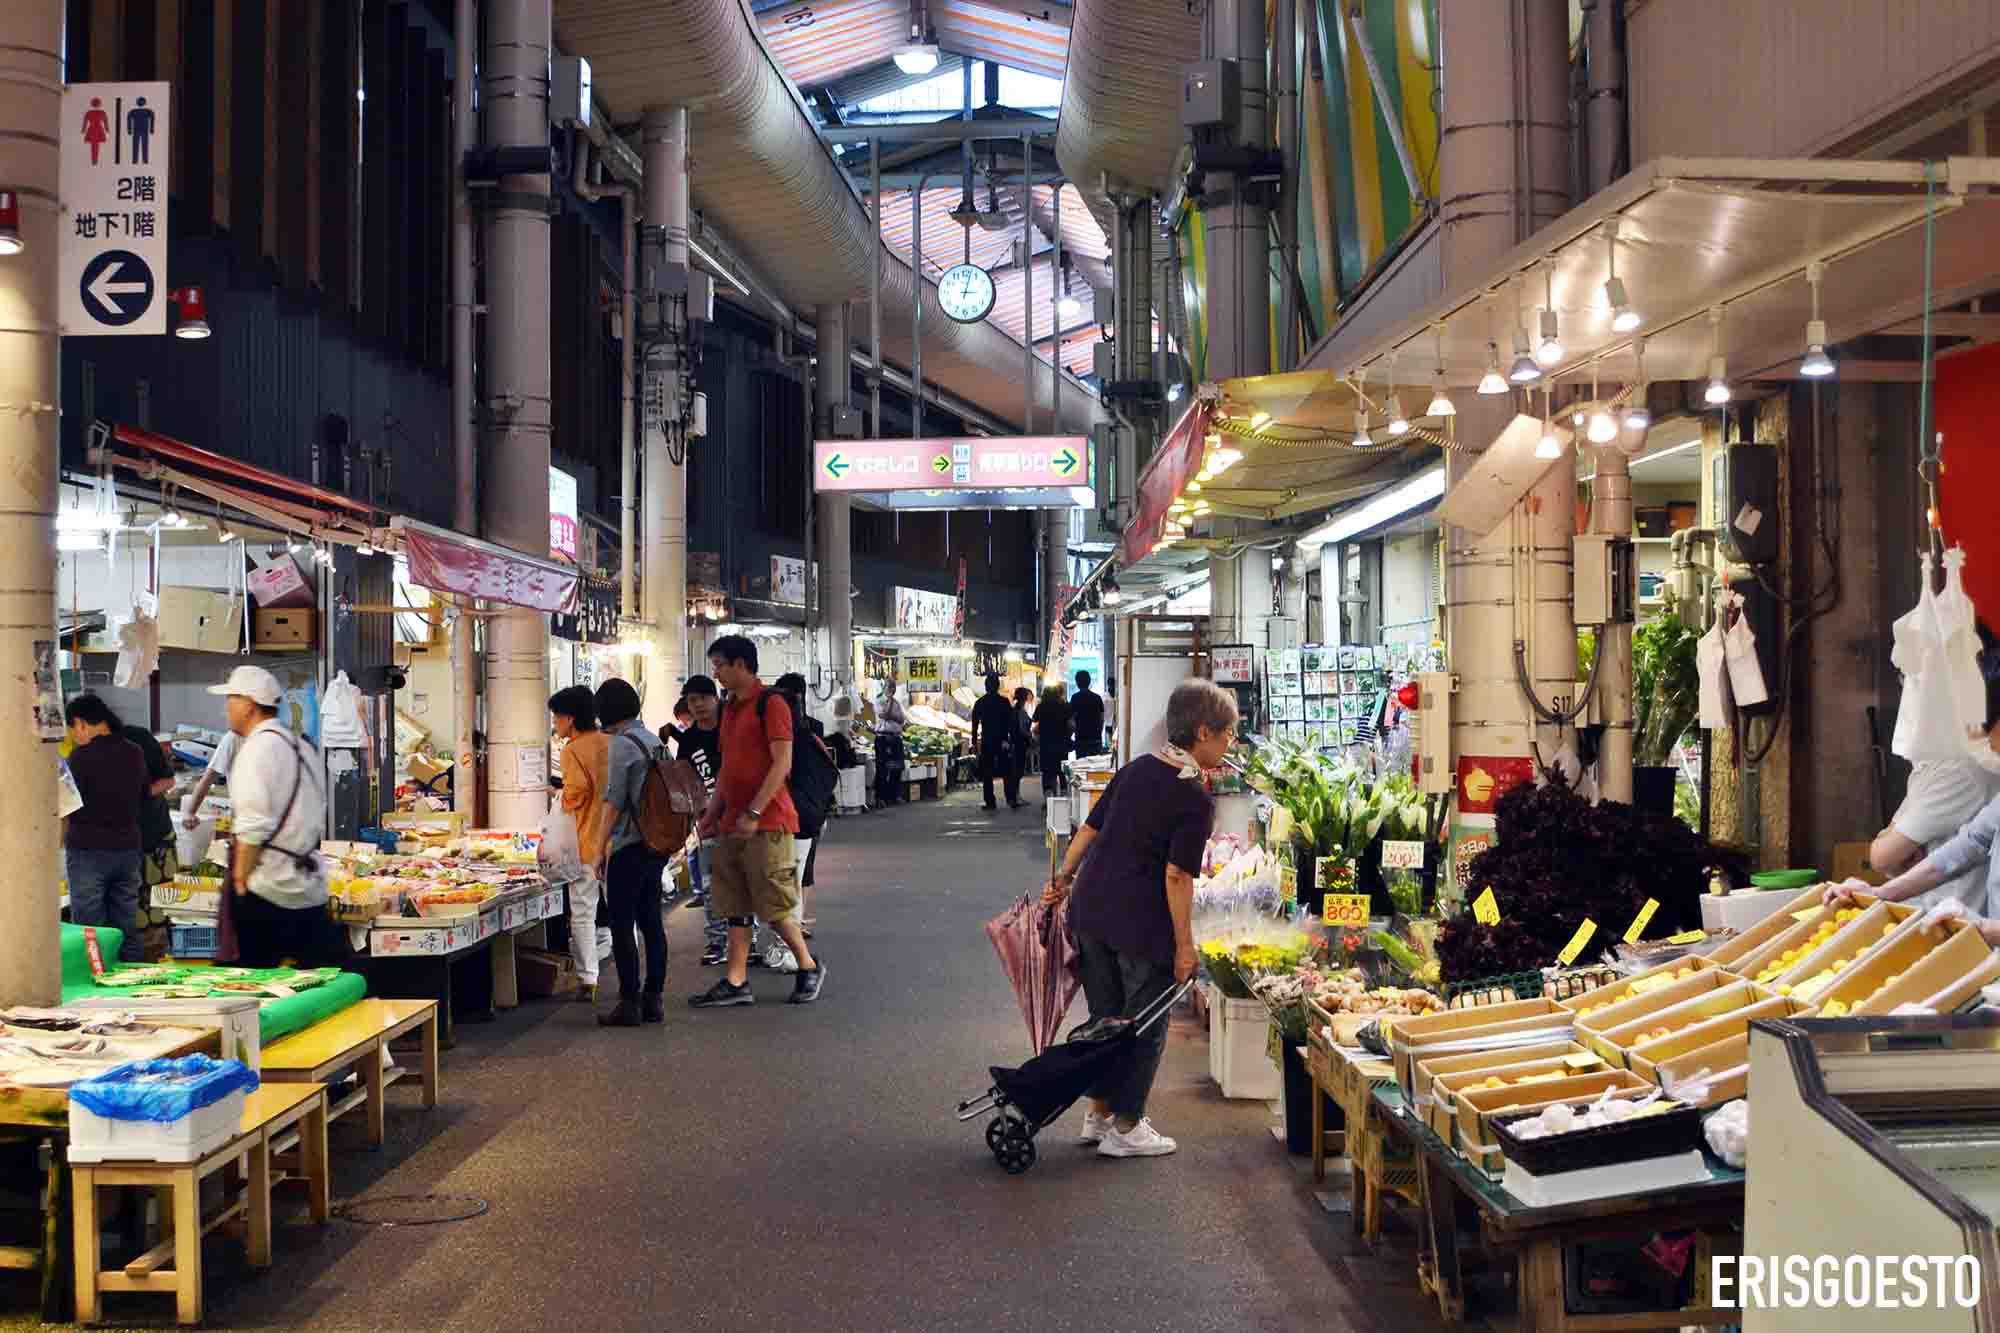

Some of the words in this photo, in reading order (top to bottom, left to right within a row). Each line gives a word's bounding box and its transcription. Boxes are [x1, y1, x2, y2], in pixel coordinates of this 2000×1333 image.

[117, 175, 155, 201] 2階
[75, 212, 155, 238] 地下1階
[1552, 696, 1571, 713] S17
